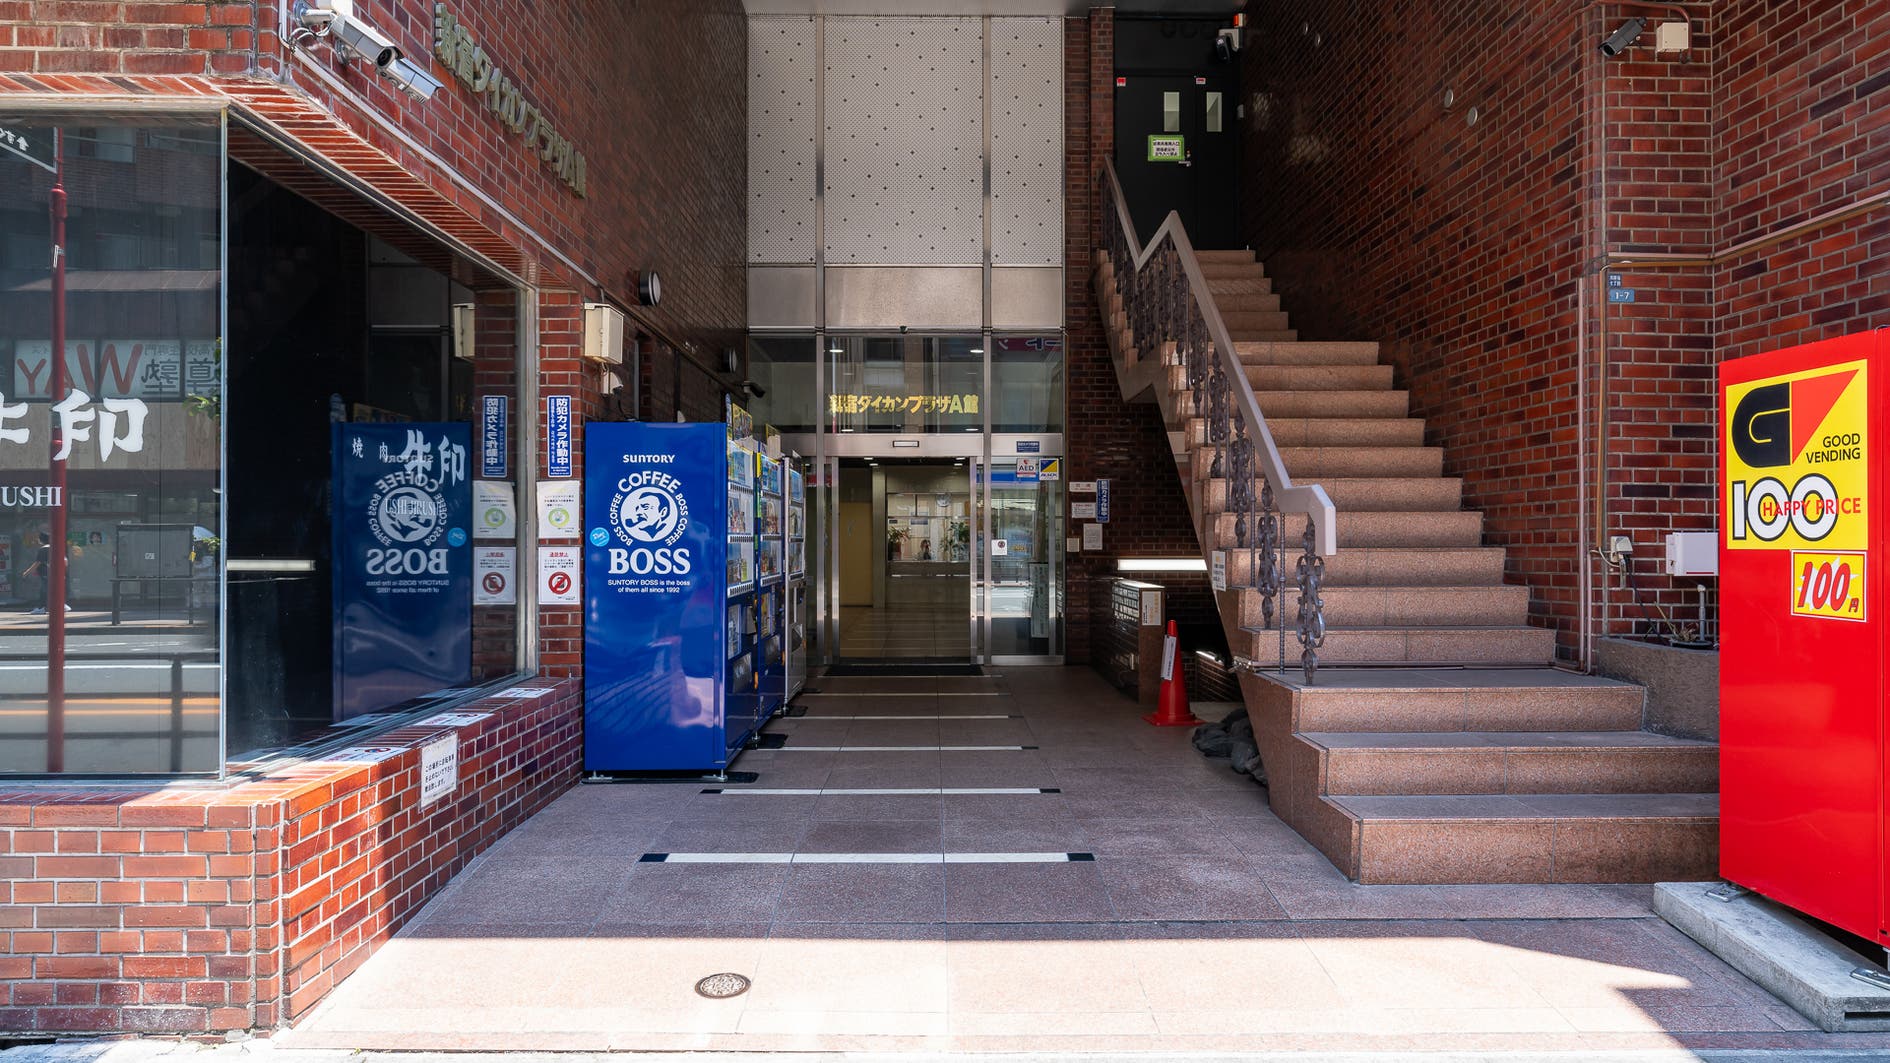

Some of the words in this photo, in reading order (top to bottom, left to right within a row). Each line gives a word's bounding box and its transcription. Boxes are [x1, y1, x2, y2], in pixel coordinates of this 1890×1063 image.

[1615, 291, 1630, 300] 1-7
[556, 398, 569, 465] 防犯カメラ作動中
[1822, 432, 1861, 448] GOOD
[1806, 447, 1861, 464] VENDING
[618, 470, 682, 494] COFFEE
[0, 486, 63, 508] USHI
[676, 493, 689, 516] BOSS
[1732, 473, 1839, 542] 100
[1763, 499, 1811, 517] HAPPY
[1815, 497, 1861, 515] PRICE
[610, 493, 624, 526] COFFEE
[613, 526, 634, 547] BOSS
[665, 517, 688, 547] COFFEE
[608, 548, 691, 575] BOSS
